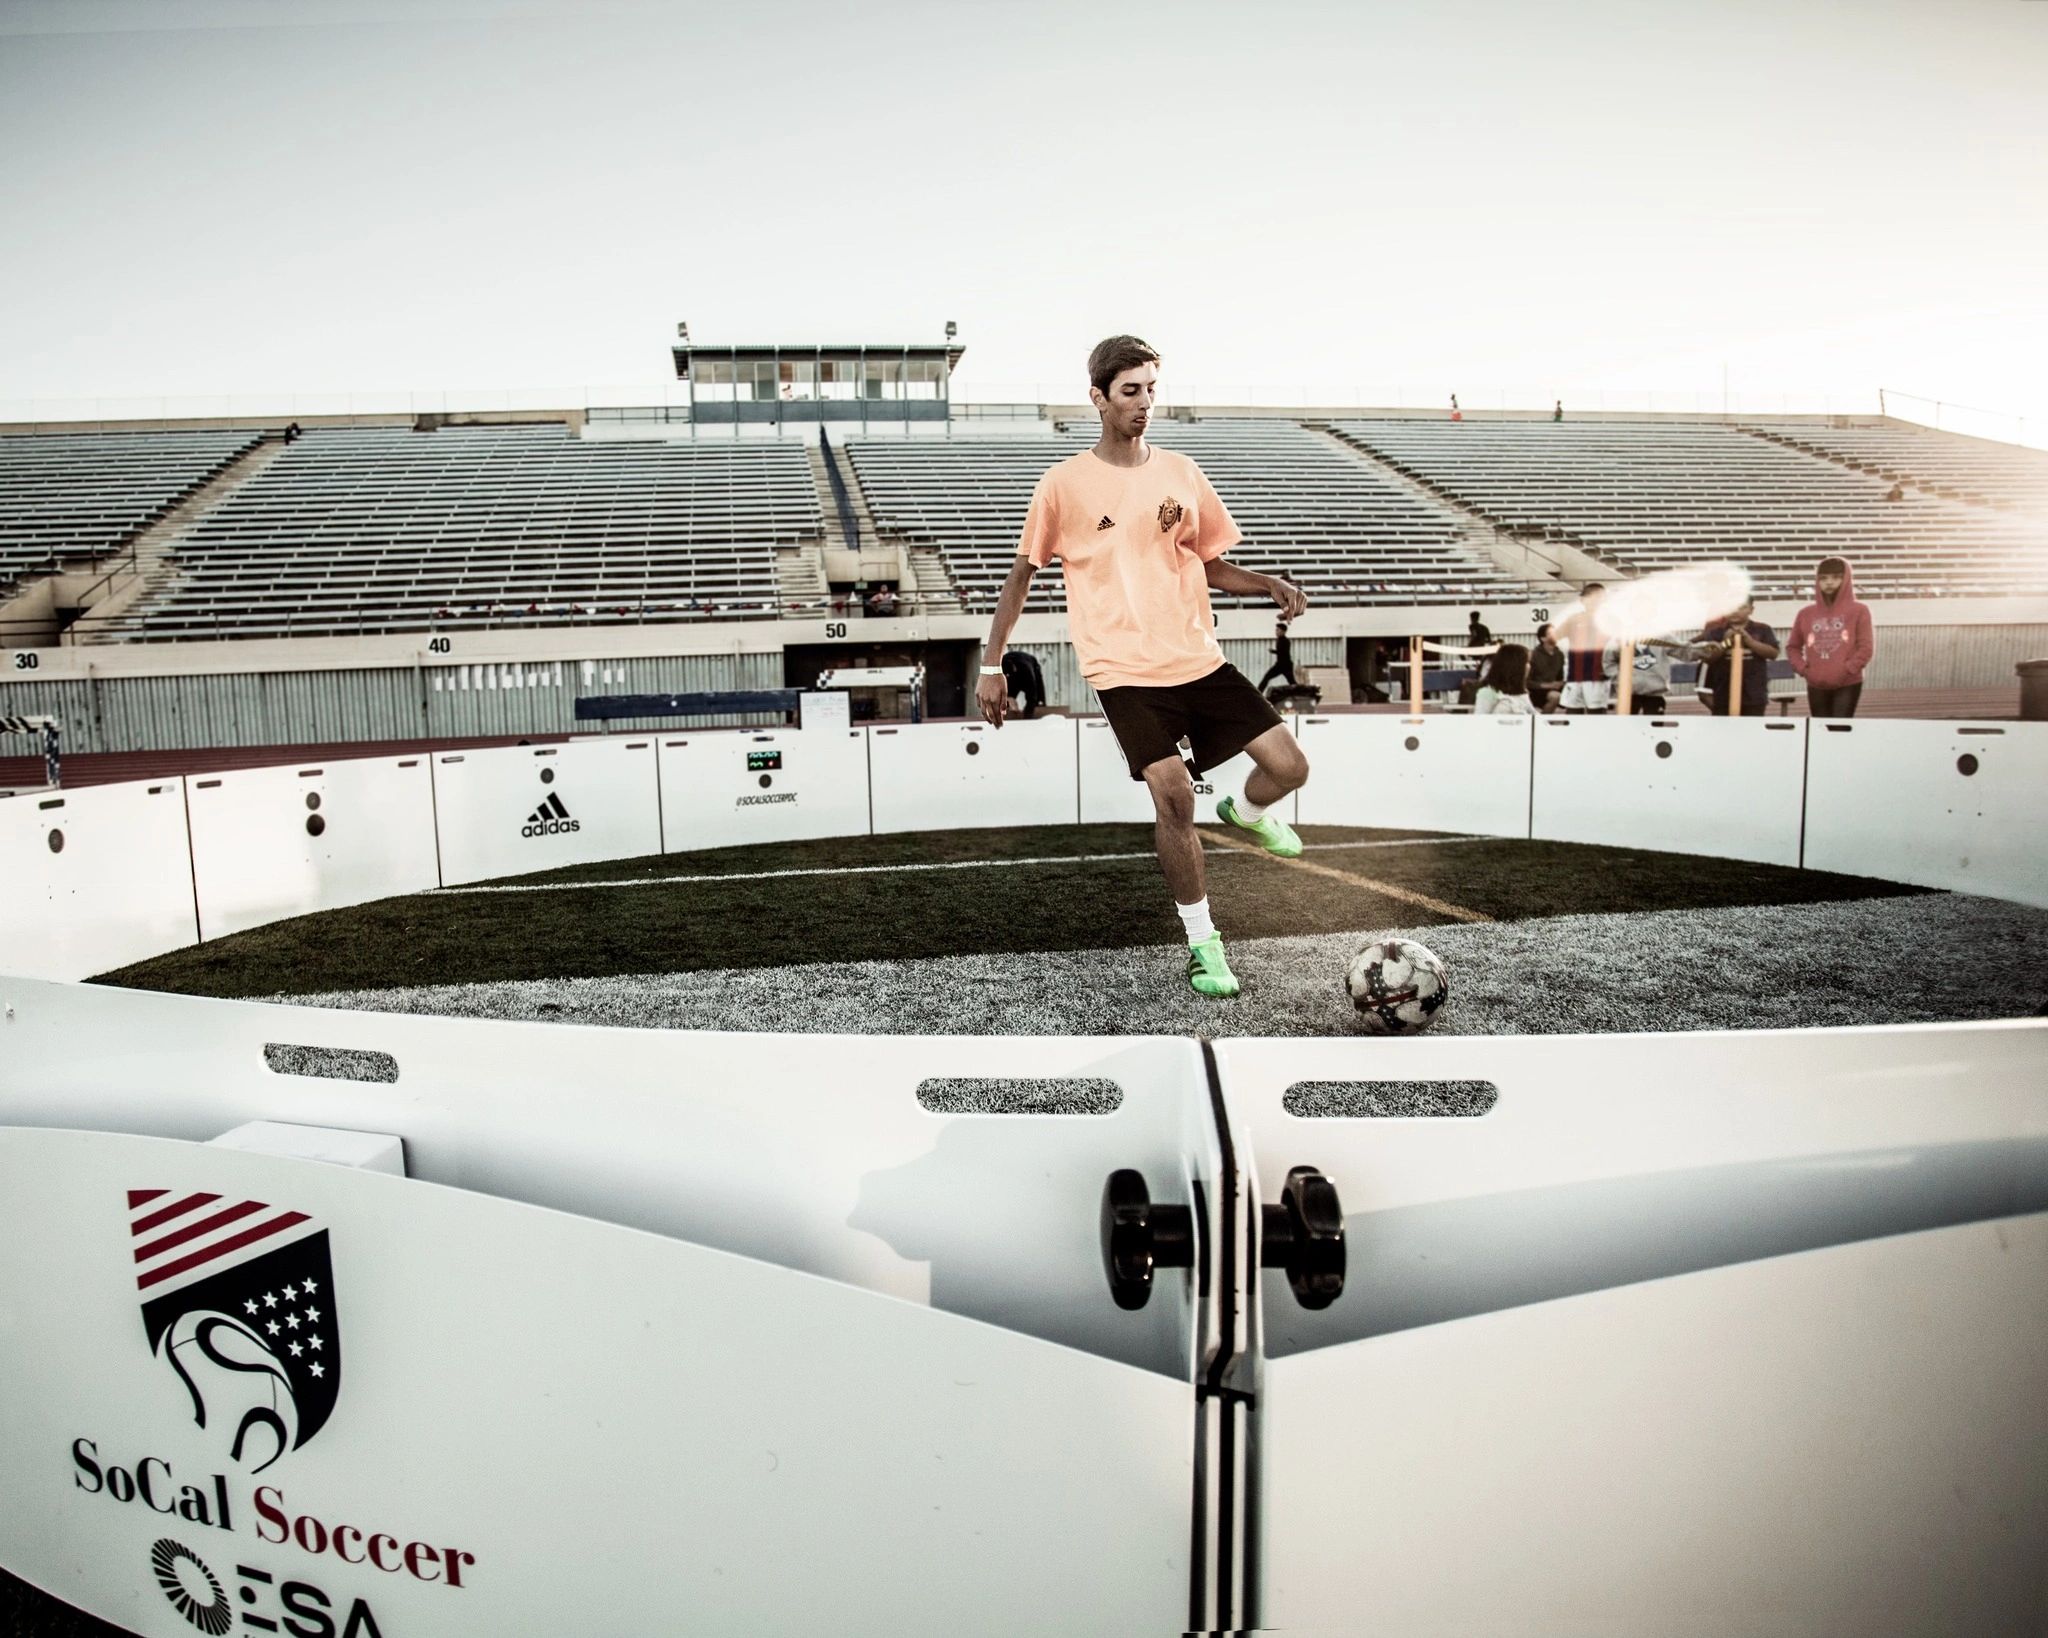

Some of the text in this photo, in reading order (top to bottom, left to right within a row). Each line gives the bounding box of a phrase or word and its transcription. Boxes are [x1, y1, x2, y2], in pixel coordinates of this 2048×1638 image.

[1532, 608, 1549, 622] 30
[826, 622, 847, 639] 50
[429, 637, 451, 653] 40
[15, 652, 38, 669] 30
[521, 818, 580, 838] adidas
[72, 1437, 476, 1588] SoCal Soccer
